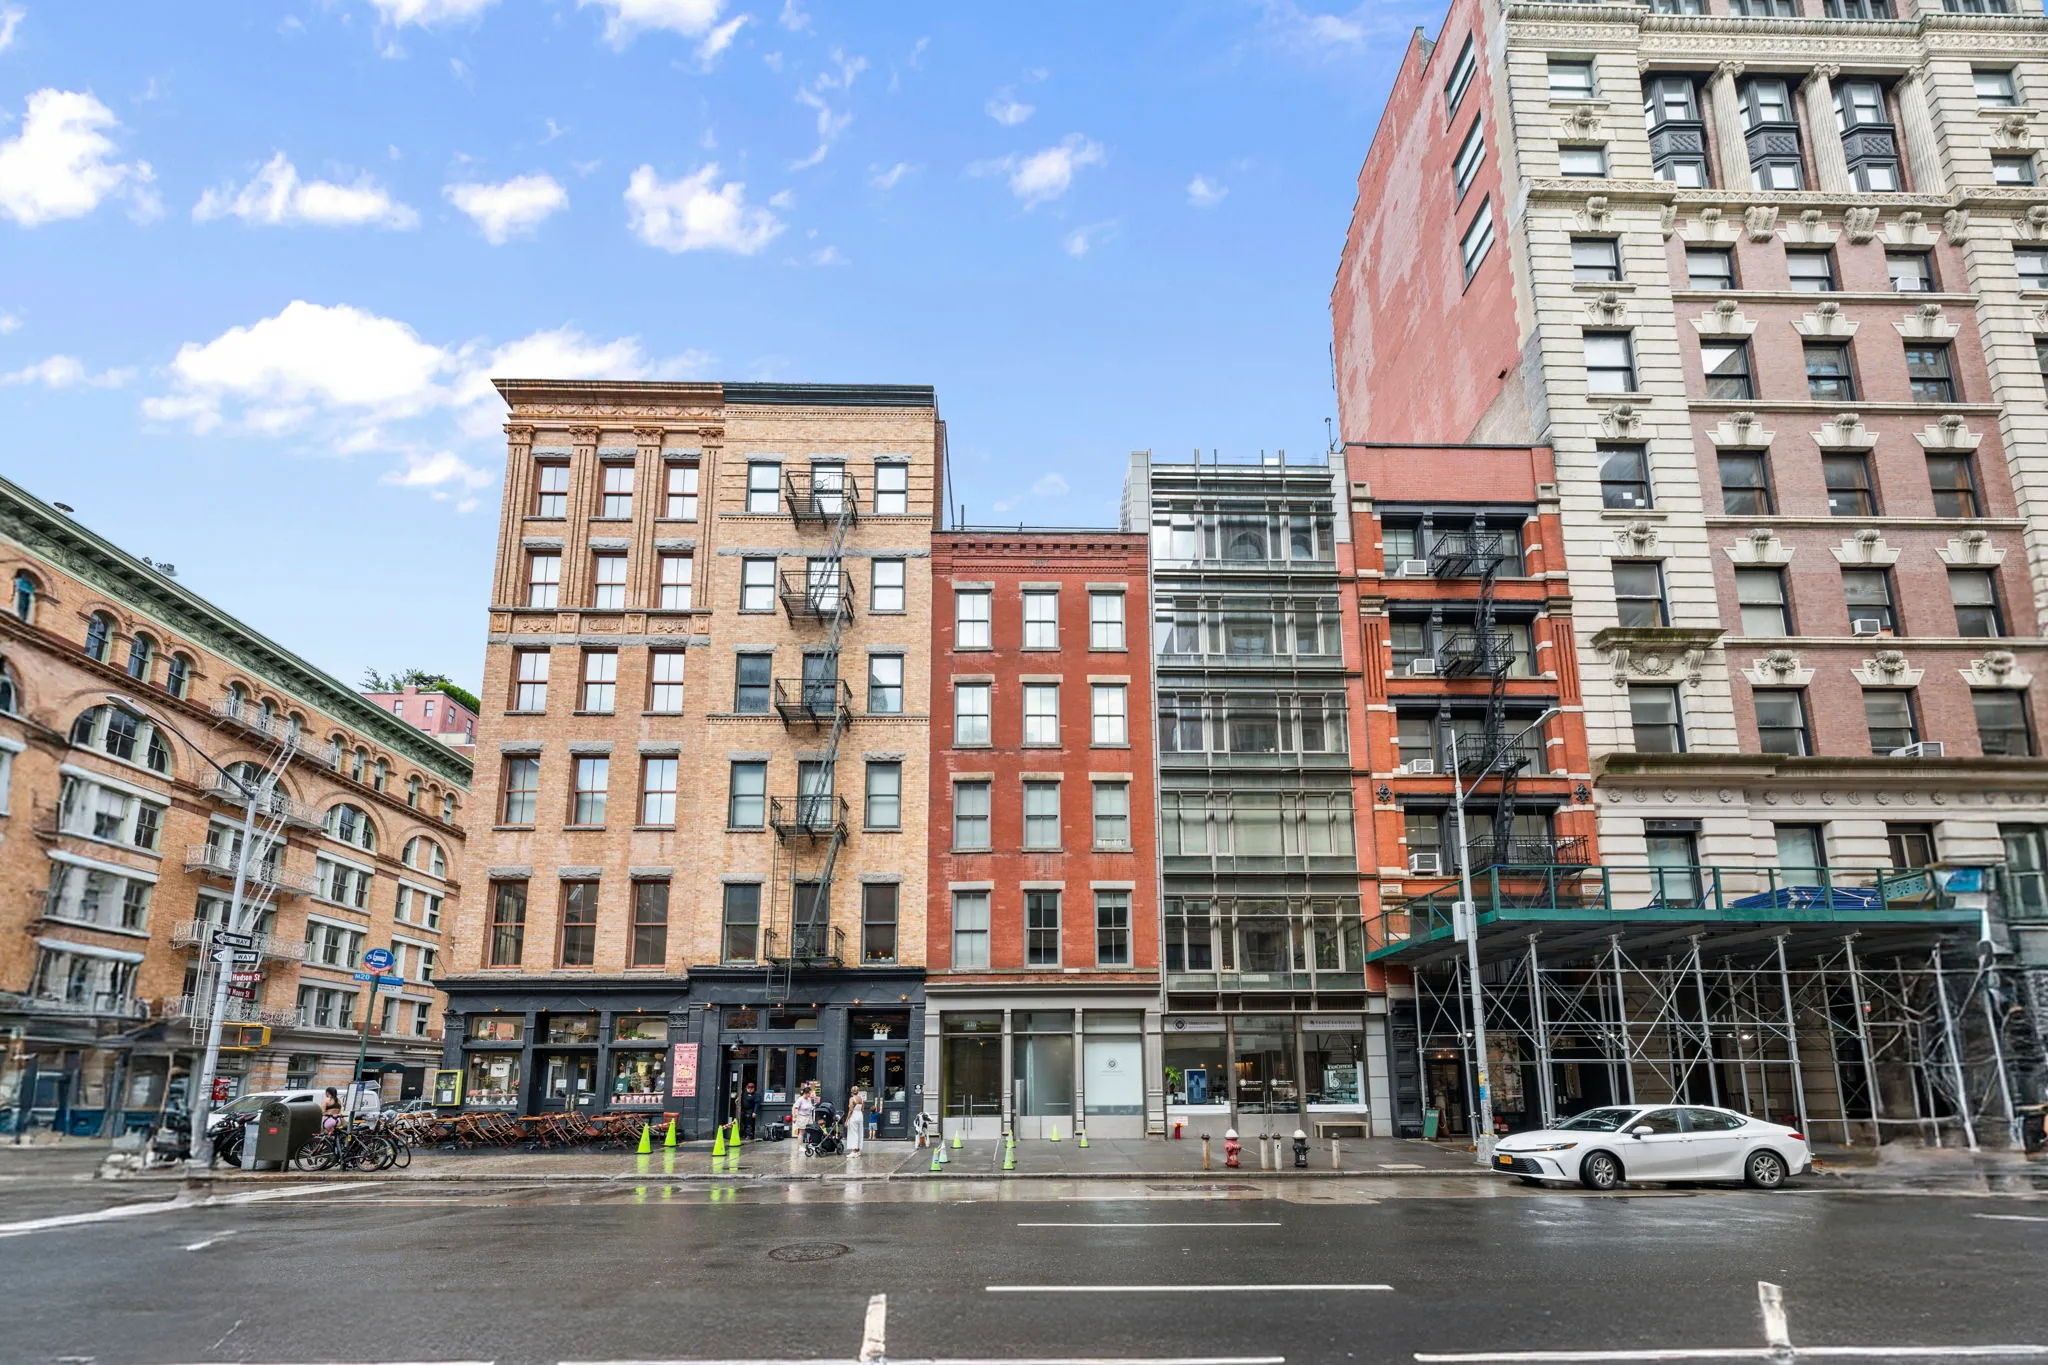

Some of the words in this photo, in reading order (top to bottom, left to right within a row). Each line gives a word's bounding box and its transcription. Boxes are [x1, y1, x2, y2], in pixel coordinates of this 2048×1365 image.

[219, 933, 231, 942] ONE
[232, 973, 253, 981] Hudson
[254, 973, 261, 981] St
